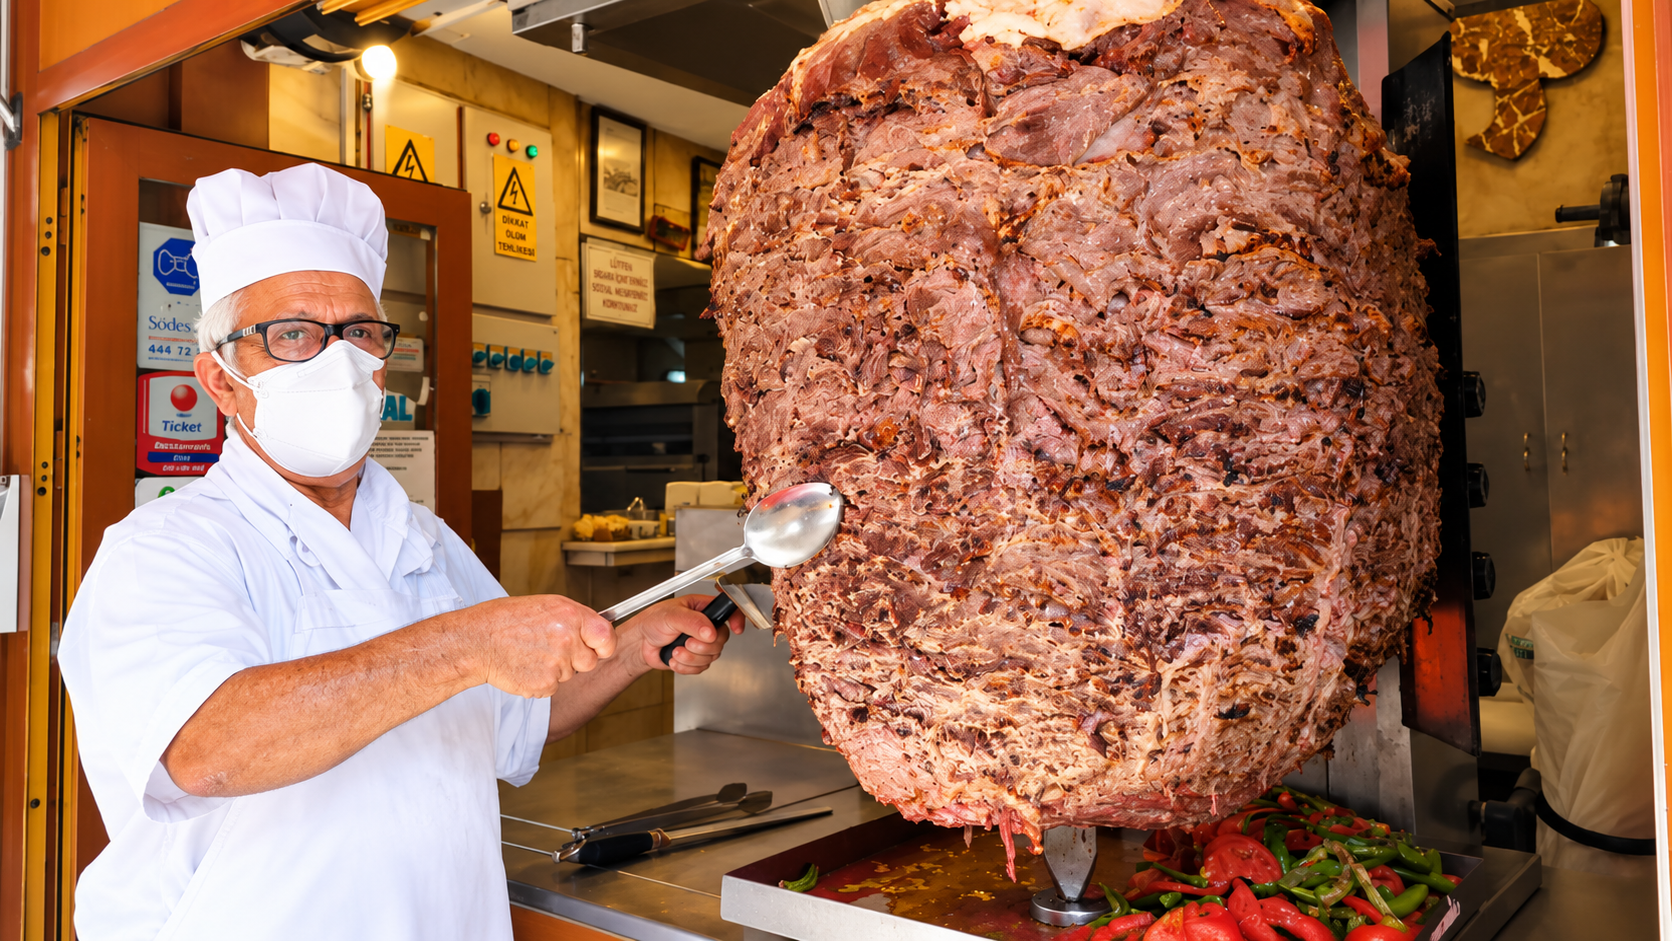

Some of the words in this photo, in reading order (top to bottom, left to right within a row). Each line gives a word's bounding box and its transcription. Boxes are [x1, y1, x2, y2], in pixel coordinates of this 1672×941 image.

[148, 344, 172, 355] 444
[177, 346, 192, 357] 72
[162, 420, 202, 433] Ticket
